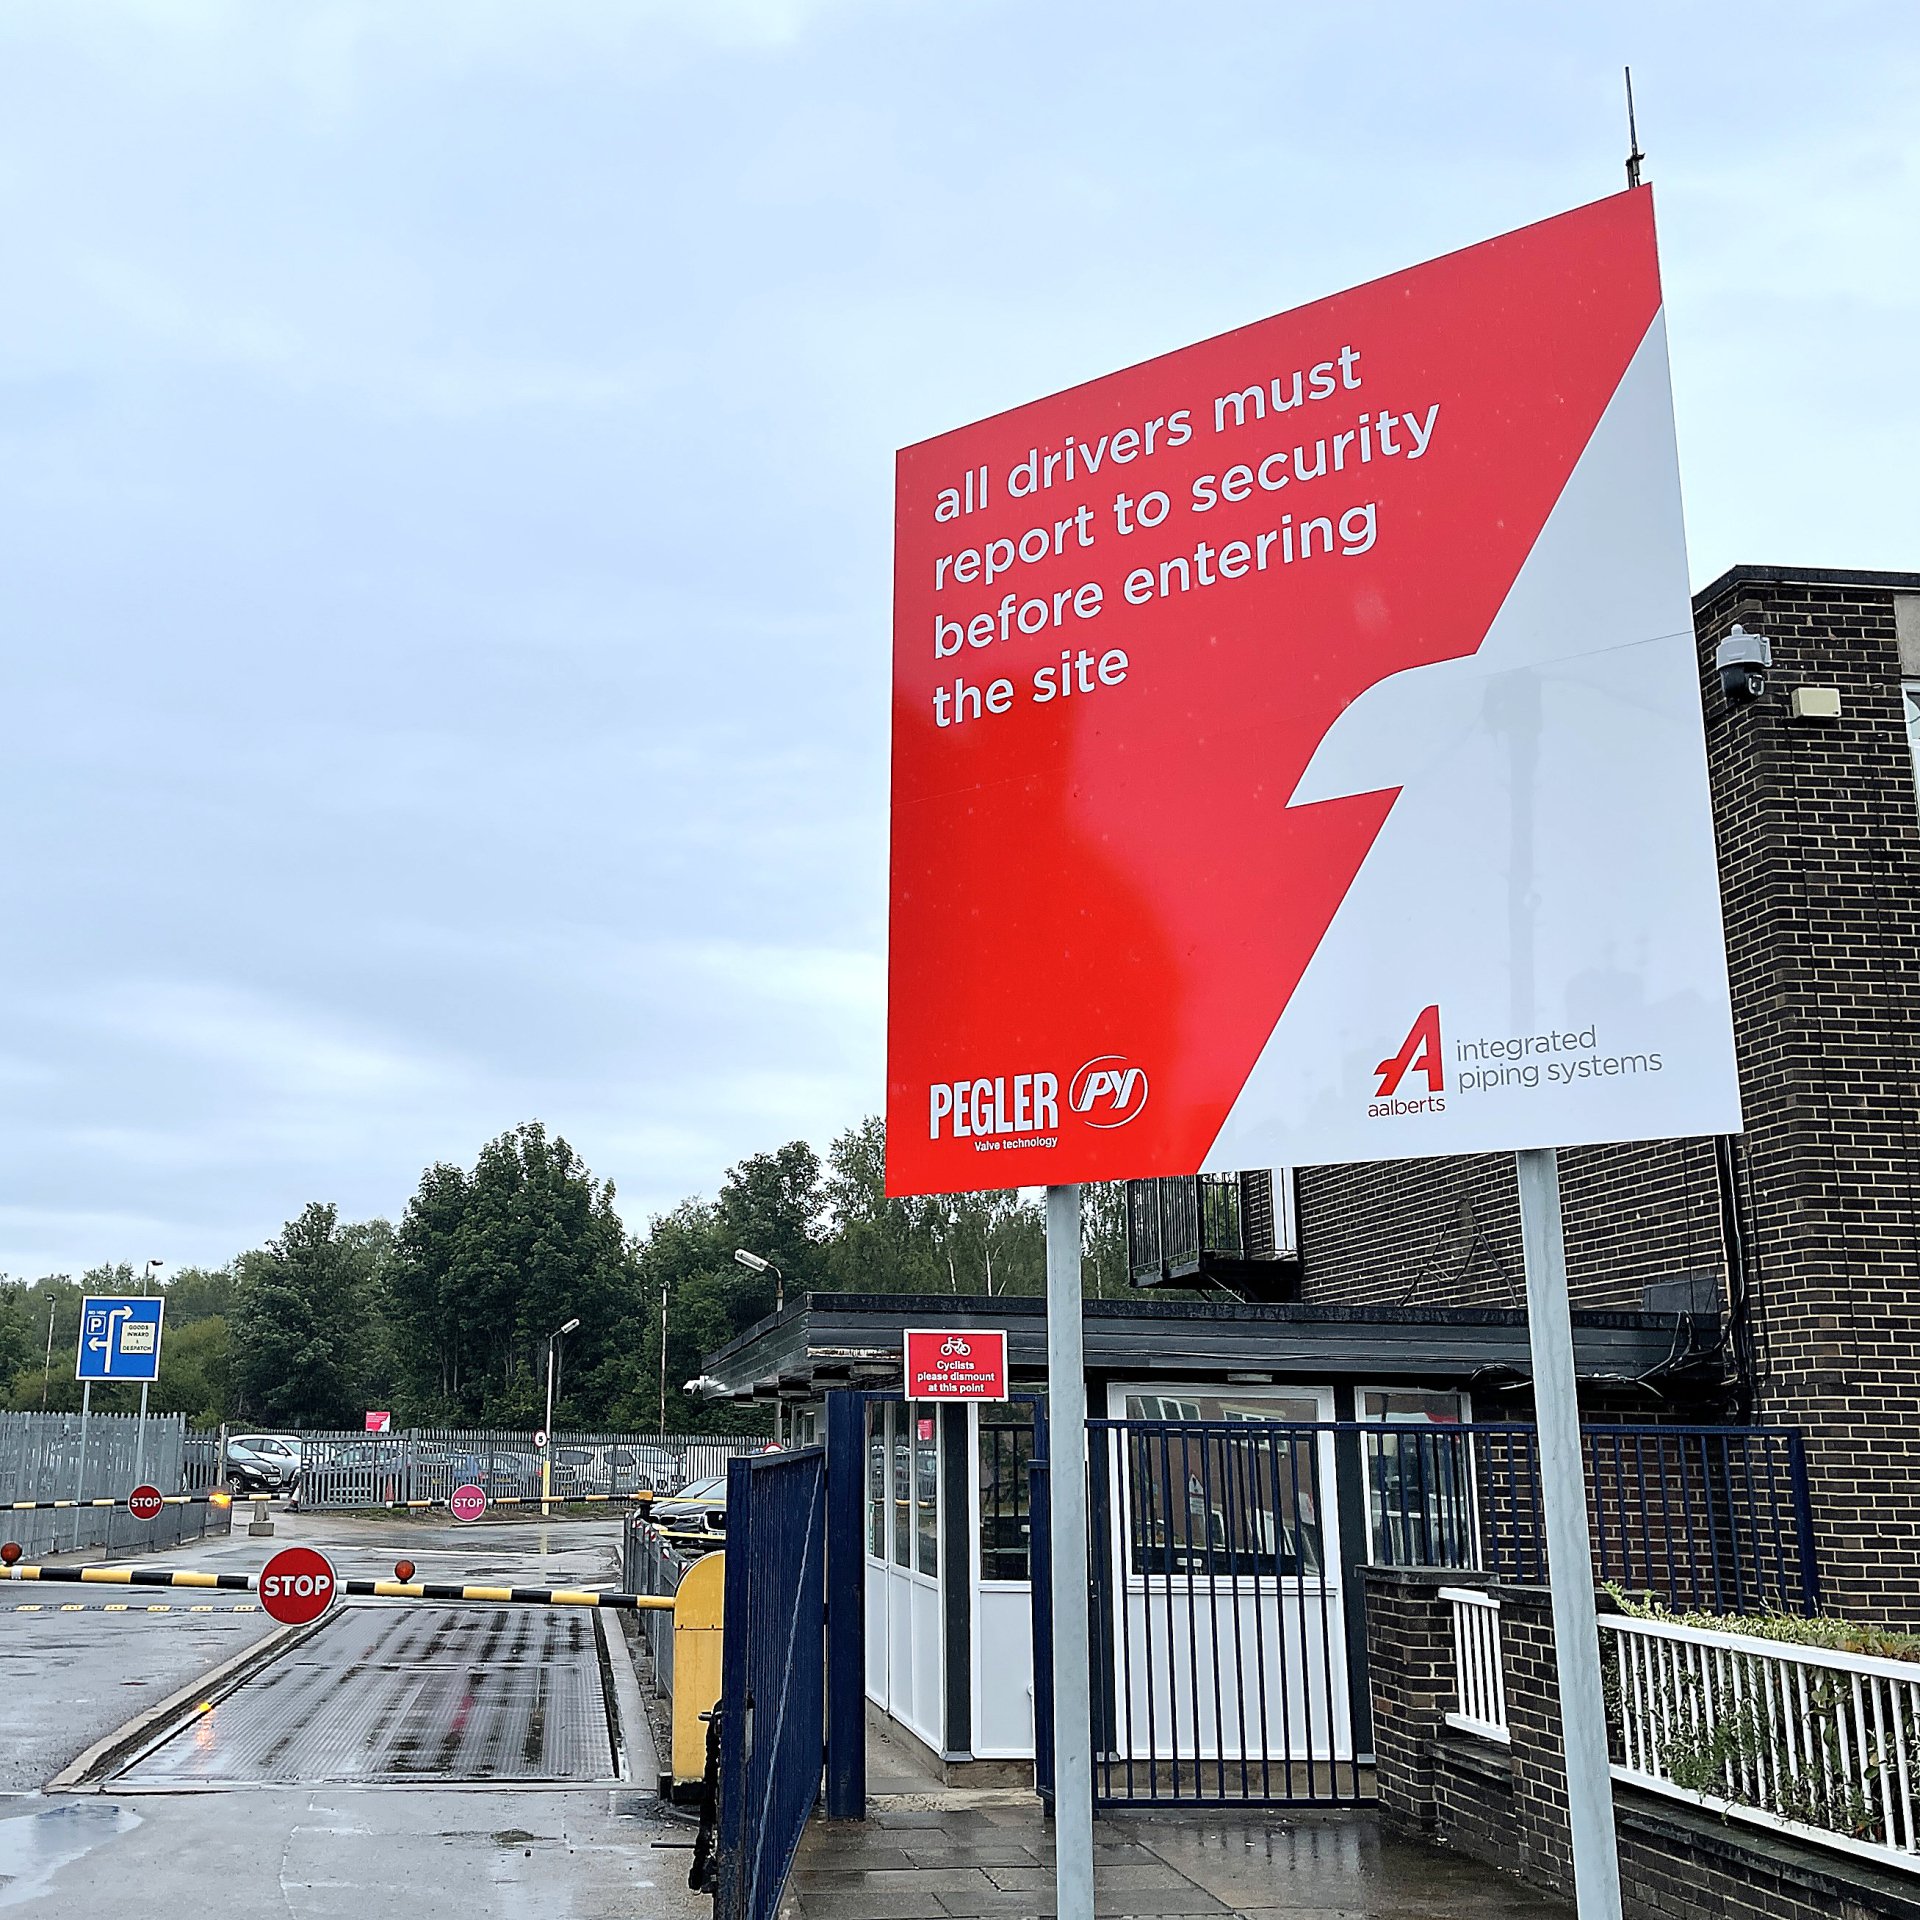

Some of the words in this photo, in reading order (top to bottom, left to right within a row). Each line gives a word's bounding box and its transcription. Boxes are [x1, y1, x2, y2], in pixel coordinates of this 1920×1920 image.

[934, 465, 988, 523] all
[1007, 409, 1192, 498] drivers
[1214, 344, 1362, 432] must
[935, 505, 1094, 590] report
[1114, 490, 1170, 535] to
[1191, 403, 1440, 513] security
[934, 581, 1104, 659] before
[1123, 502, 1377, 604] entering
[933, 677, 1014, 728] the
[1032, 648, 1129, 703] site
[1456, 1024, 1597, 1062] integrated
[1458, 1063, 1540, 1094] piping
[1547, 1052, 1663, 1085] systems
[930, 1072, 1058, 1139] PEGLER
[1367, 1096, 1446, 1118] aalberts
[974, 1138, 1000, 1152] Valve
[1003, 1135, 1058, 1149] technology
[91, 1318, 102, 1332] P
[917, 1371, 949, 1382] please
[950, 1371, 995, 1381] dismount
[936, 1360, 975, 1372] Cyclists
[928, 1383, 938, 1392] at
[939, 1382, 957, 1392] this
[960, 1383, 984, 1393] point
[131, 1497, 160, 1508] STOP
[454, 1497, 483, 1508] STOP
[264, 1574, 331, 1597] STOP
